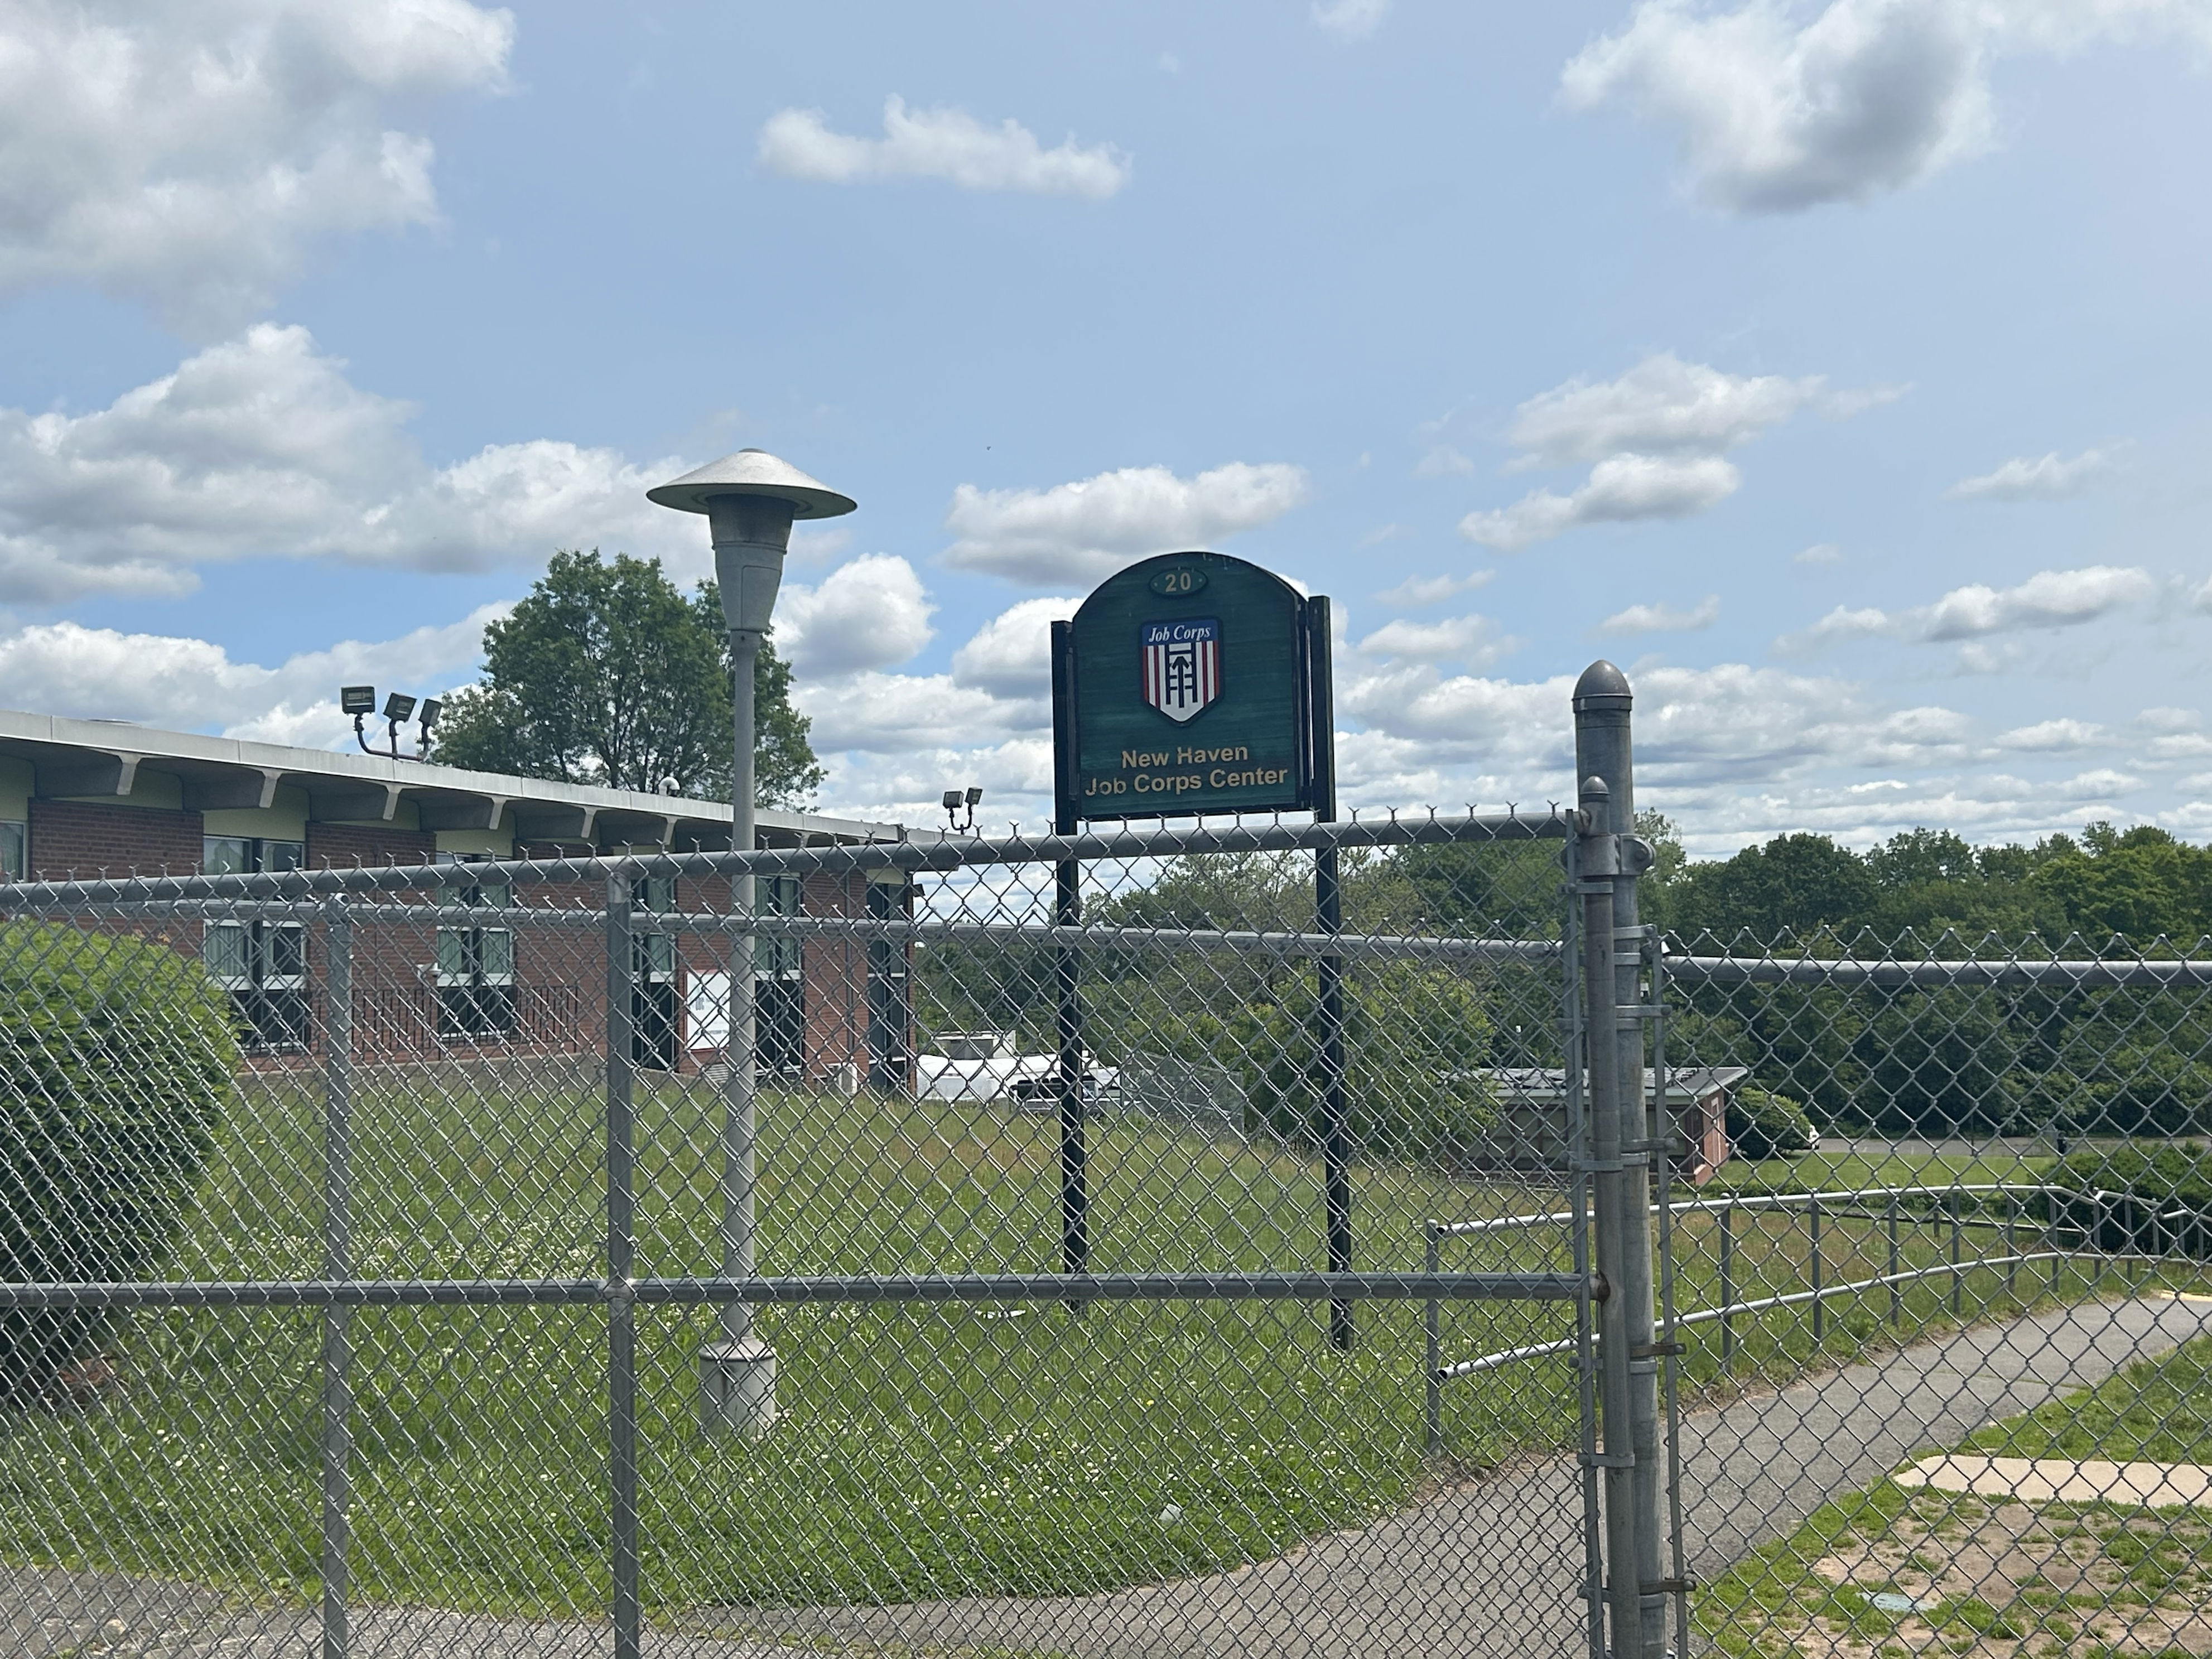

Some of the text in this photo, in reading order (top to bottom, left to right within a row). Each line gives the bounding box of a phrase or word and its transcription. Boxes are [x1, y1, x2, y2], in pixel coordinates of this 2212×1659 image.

[1165, 572, 1192, 592] 20
[1148, 625, 1211, 642] Job Corps
[1122, 746, 1248, 769] New Haven
[1085, 767, 1288, 796] Job Corps Center
